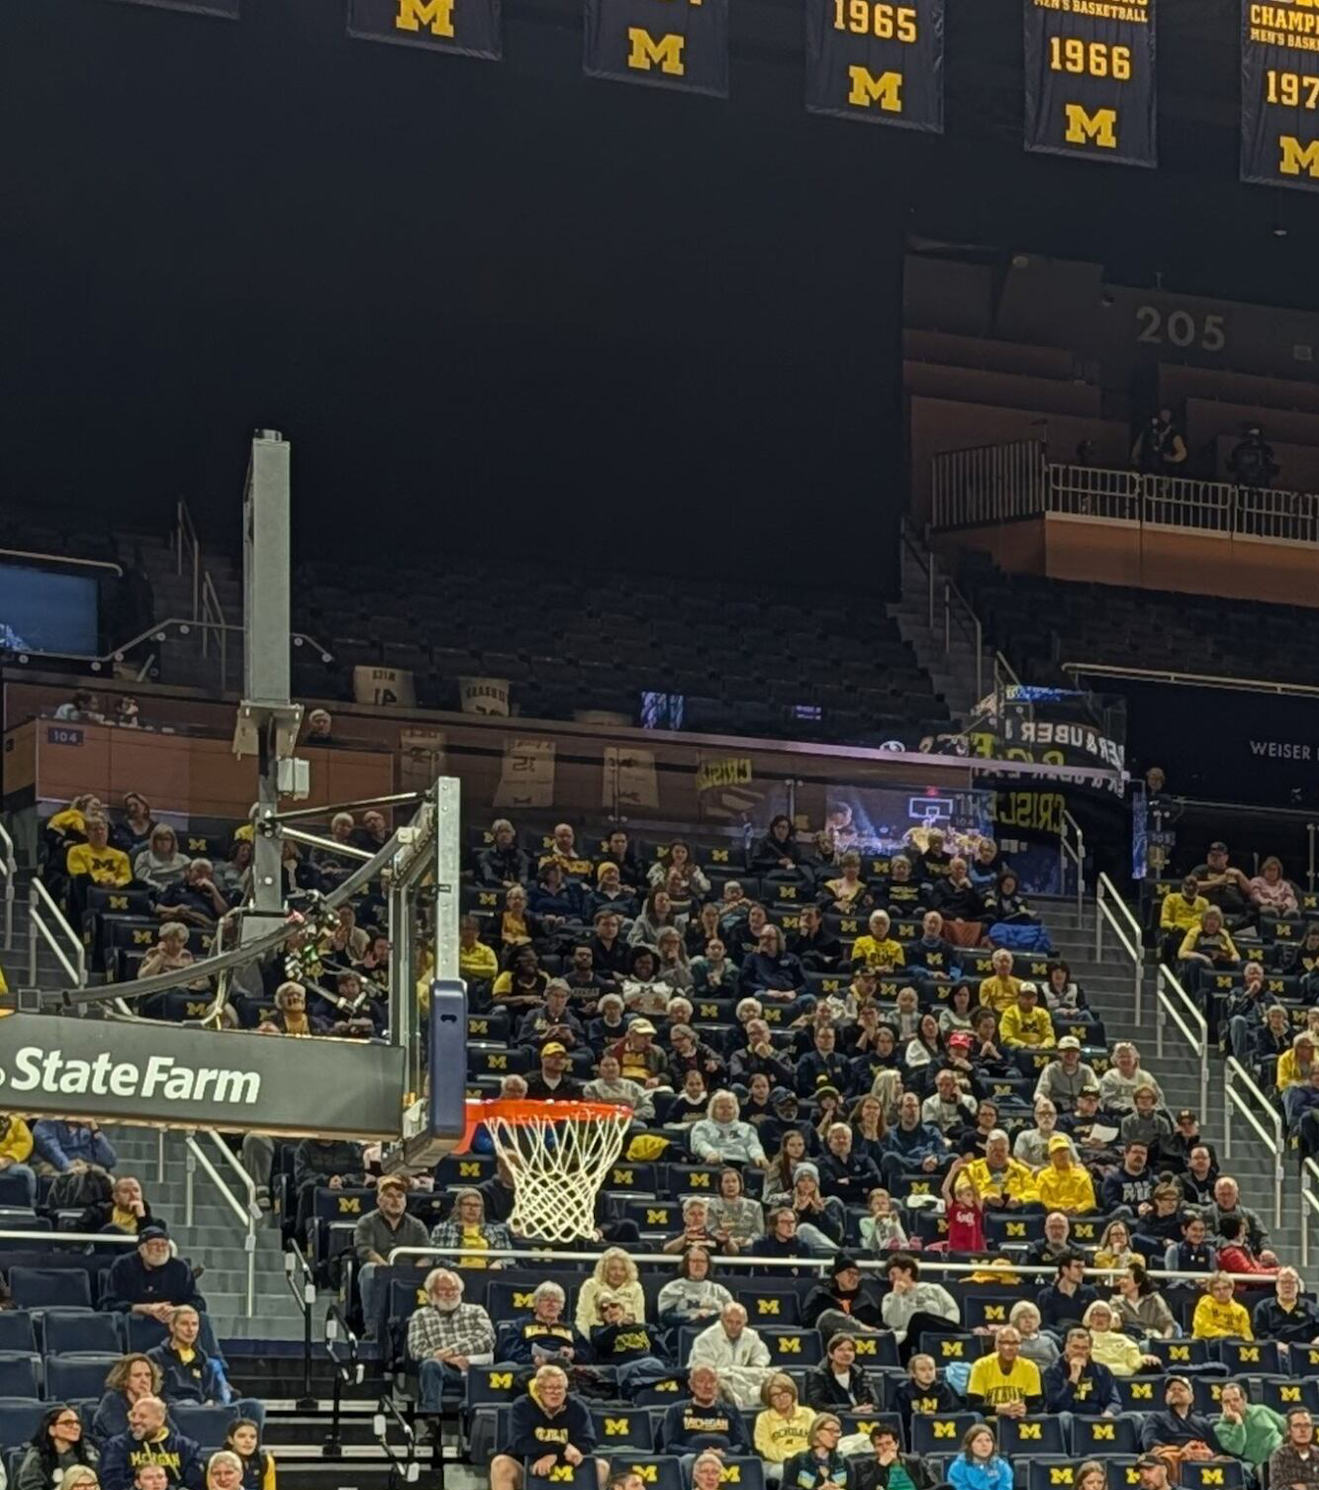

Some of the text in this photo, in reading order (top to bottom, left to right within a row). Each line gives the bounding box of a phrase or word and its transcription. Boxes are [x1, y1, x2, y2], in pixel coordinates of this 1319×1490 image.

[395, 0, 454, 38] M
[833, 0, 917, 43] 1965
[1072, 2, 1149, 23] BASKETBALL
[628, 26, 685, 76] M
[1249, 28, 1285, 46] MEN'S
[1049, 36, 1131, 80] 1966
[848, 65, 903, 112] M
[1065, 103, 1117, 149] M
[1136, 305, 1226, 351] 205
[53, 731, 78, 743] 104
[1249, 740, 1311, 761] WEISER
[10, 1045, 261, 1104] StateFarm
[605, 1419, 630, 1436] M
[1019, 1424, 1043, 1441] M
